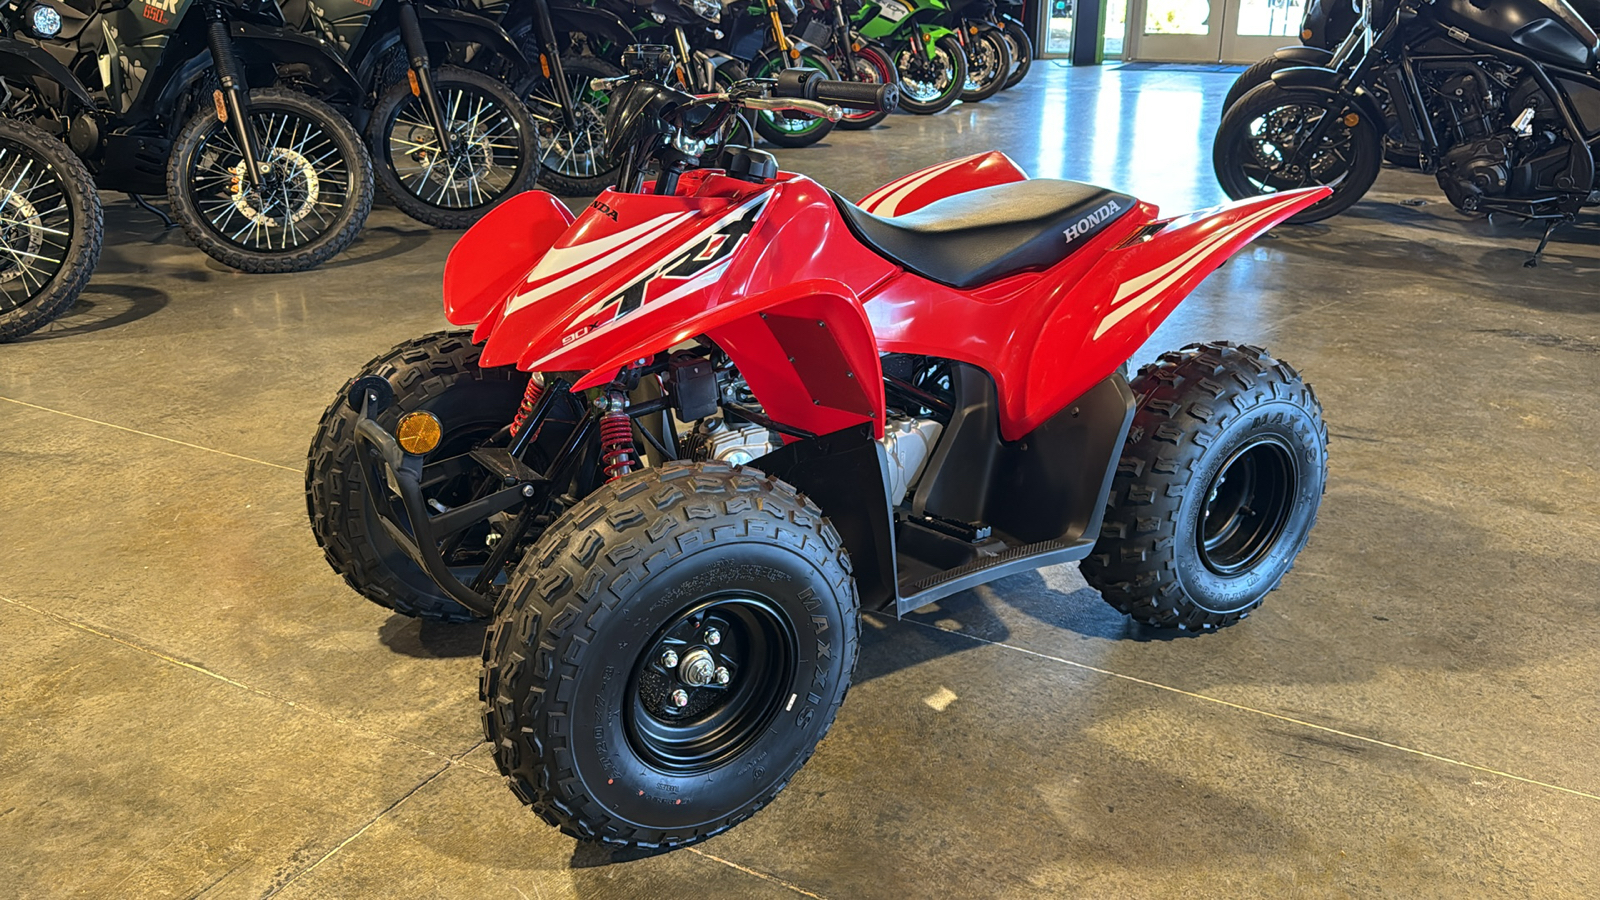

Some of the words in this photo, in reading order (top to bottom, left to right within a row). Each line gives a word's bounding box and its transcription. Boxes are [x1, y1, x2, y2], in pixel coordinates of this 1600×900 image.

[143, 4, 164, 23] 650
[1063, 200, 1121, 243] HONDA
[796, 586, 832, 730] MAXXIS
